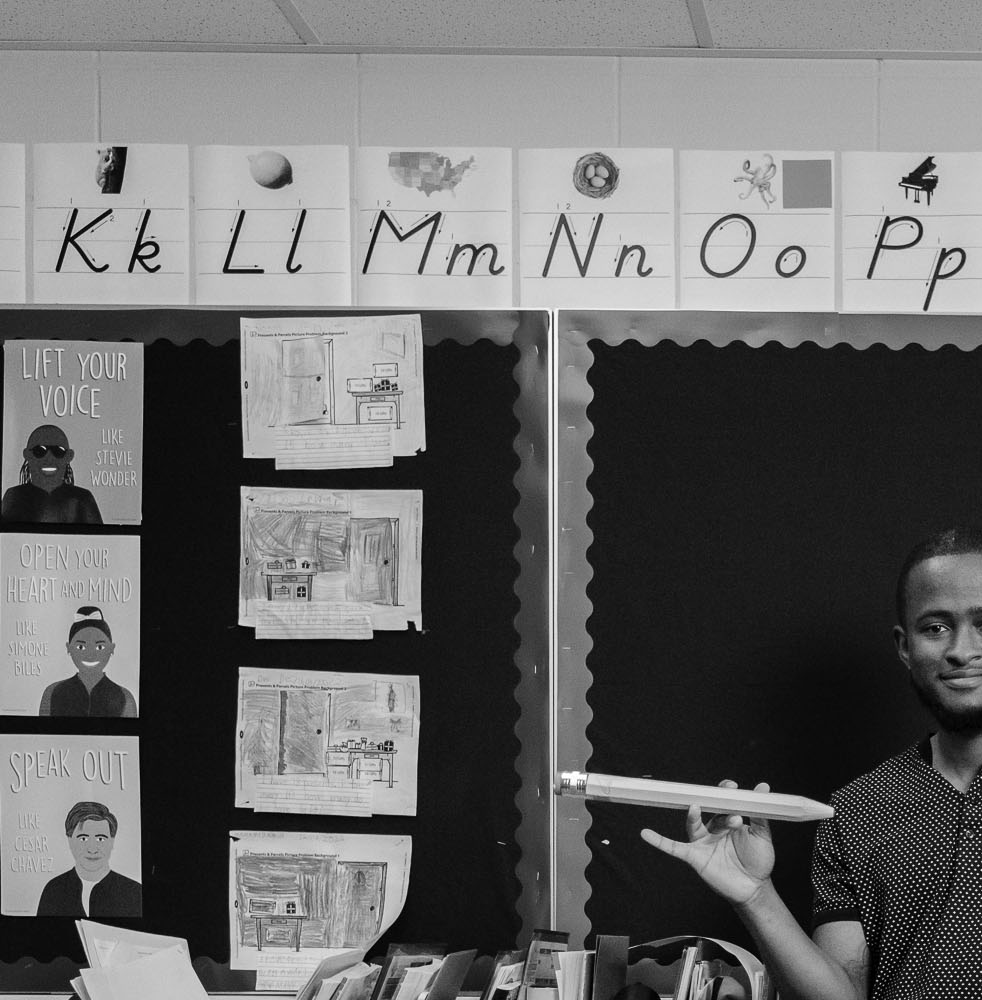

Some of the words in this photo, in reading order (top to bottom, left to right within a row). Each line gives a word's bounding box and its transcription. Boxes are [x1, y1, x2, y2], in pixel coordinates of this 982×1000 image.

[22, 347, 65, 381] LIFT
[77, 351, 127, 382] YOUR
[39, 384, 101, 419] VOICE
[101, 428, 124, 446] LIKE
[95, 450, 133, 466] STEVIE
[90, 469, 138, 487] WONDER
[19, 543, 70, 571] OPEN
[75, 547, 109, 570] YOUR
[6, 575, 57, 604] HEART
[60, 580, 85, 600] AND
[87, 576, 133, 604] MIND
[15, 620, 38, 637] LIKE
[8, 640, 49, 657] SIMONE
[14, 660, 42, 677] BILES
[9, 747, 70, 794] SPEAK
[82, 749, 129, 791] OUT
[18, 812, 40, 830] LIKE
[14, 835, 49, 853] CESAR
[10, 855, 54, 873] CHAVEZ
